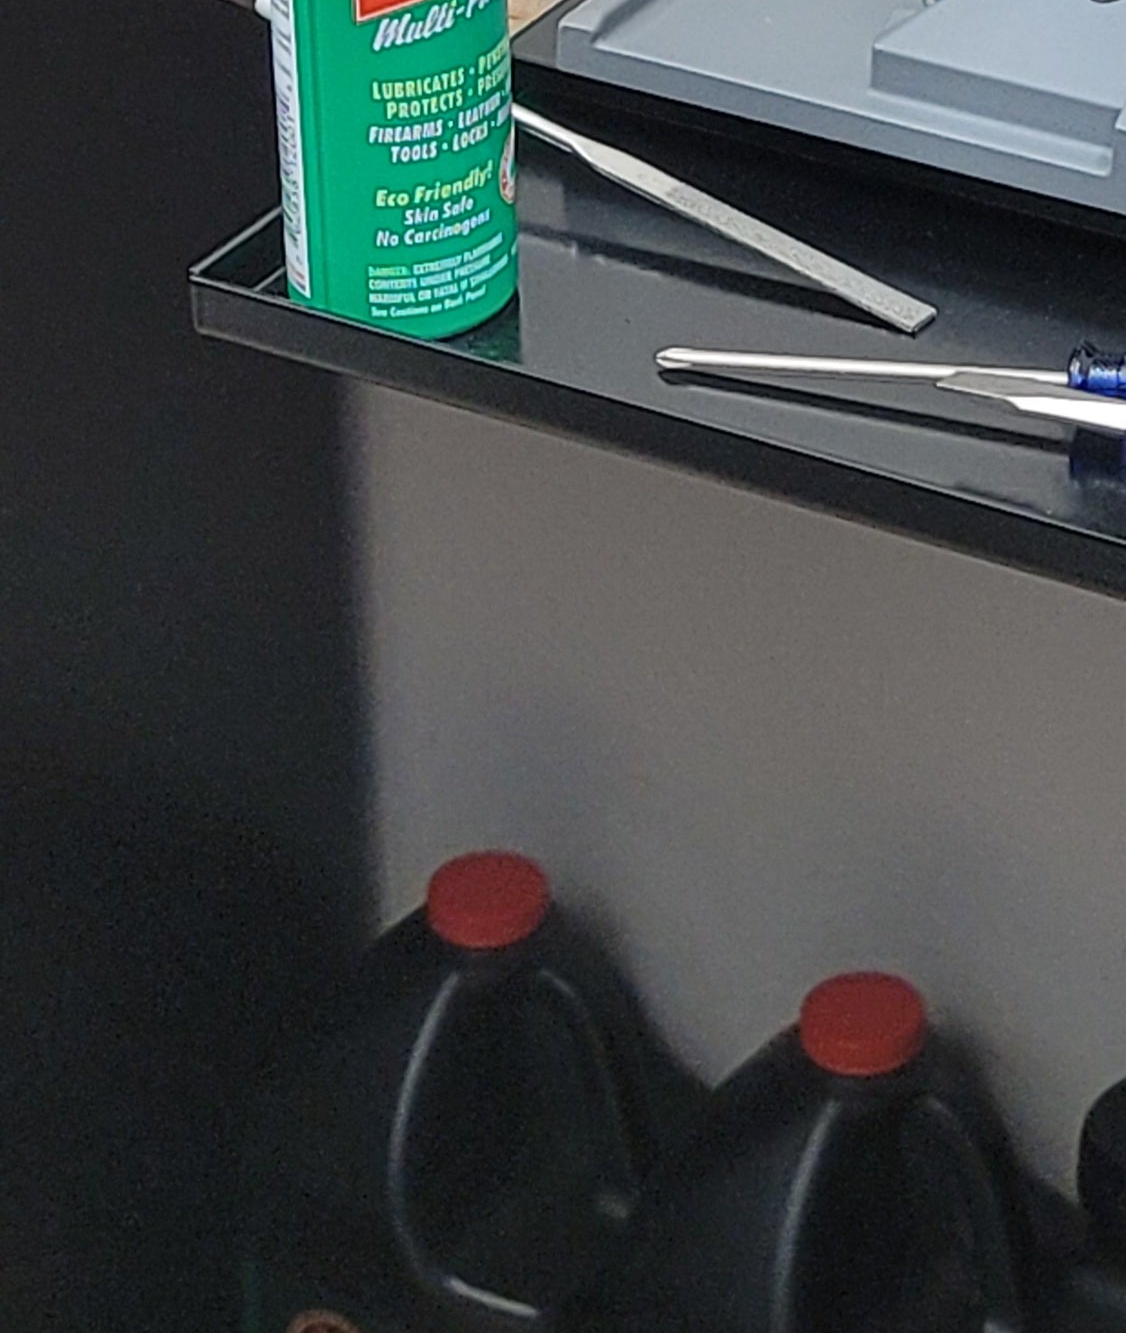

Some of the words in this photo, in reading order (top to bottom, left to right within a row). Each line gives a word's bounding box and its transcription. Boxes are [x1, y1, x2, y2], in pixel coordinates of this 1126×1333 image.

[373, 67, 464, 100] LUBRICATES
[387, 88, 462, 120] PROTECTS
[369, 119, 443, 144] FIREARMS
[391, 141, 437, 163] TOOLS
[453, 120, 488, 151] LOCKS
[376, 189, 409, 207] Eco
[414, 159, 493, 204] Friendly!
[404, 206, 439, 225] Skin
[442, 195, 474, 218] Safe
[376, 230, 399, 247] No
[404, 208, 490, 245] Carcinogens
